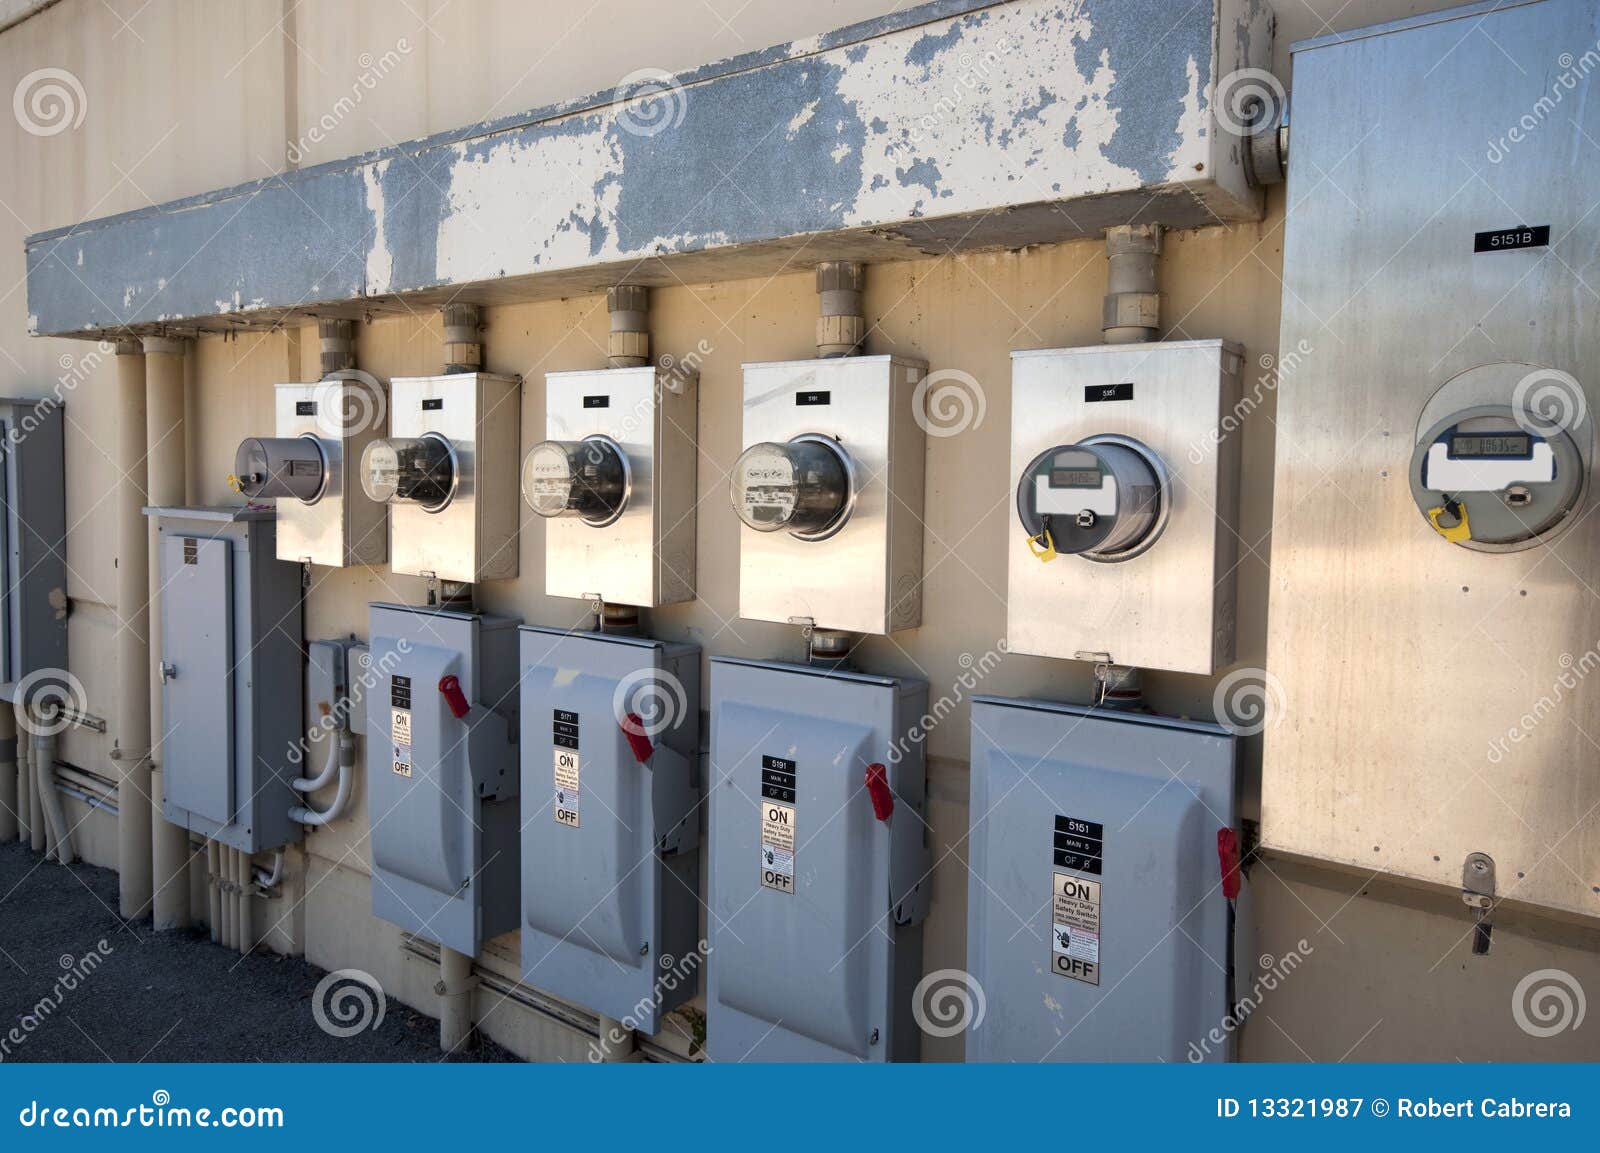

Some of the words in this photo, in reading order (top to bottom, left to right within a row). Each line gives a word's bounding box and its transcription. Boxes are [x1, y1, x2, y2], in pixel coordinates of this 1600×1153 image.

[1491, 232, 1532, 246] 5151B
[395, 714, 407, 726] ON
[394, 761, 410, 774] OFF
[559, 754, 574, 768] ON
[772, 759, 787, 770] 5191
[769, 788, 778, 796] OF
[557, 808, 577, 823] OFF
[769, 809, 788, 825] ON
[1068, 821, 1089, 834] 5151
[1066, 839, 1082, 849] MAIN
[1064, 855, 1077, 865] OF
[1083, 859, 1090, 869] 6
[765, 871, 791, 888] OFF
[1063, 881, 1090, 901] ON
[1058, 896, 1079, 909] Heavy
[1079, 902, 1095, 913] Duty
[1055, 903, 1076, 916] Safety
[1076, 909, 1098, 921] Switch
[1057, 955, 1095, 977] OFF
